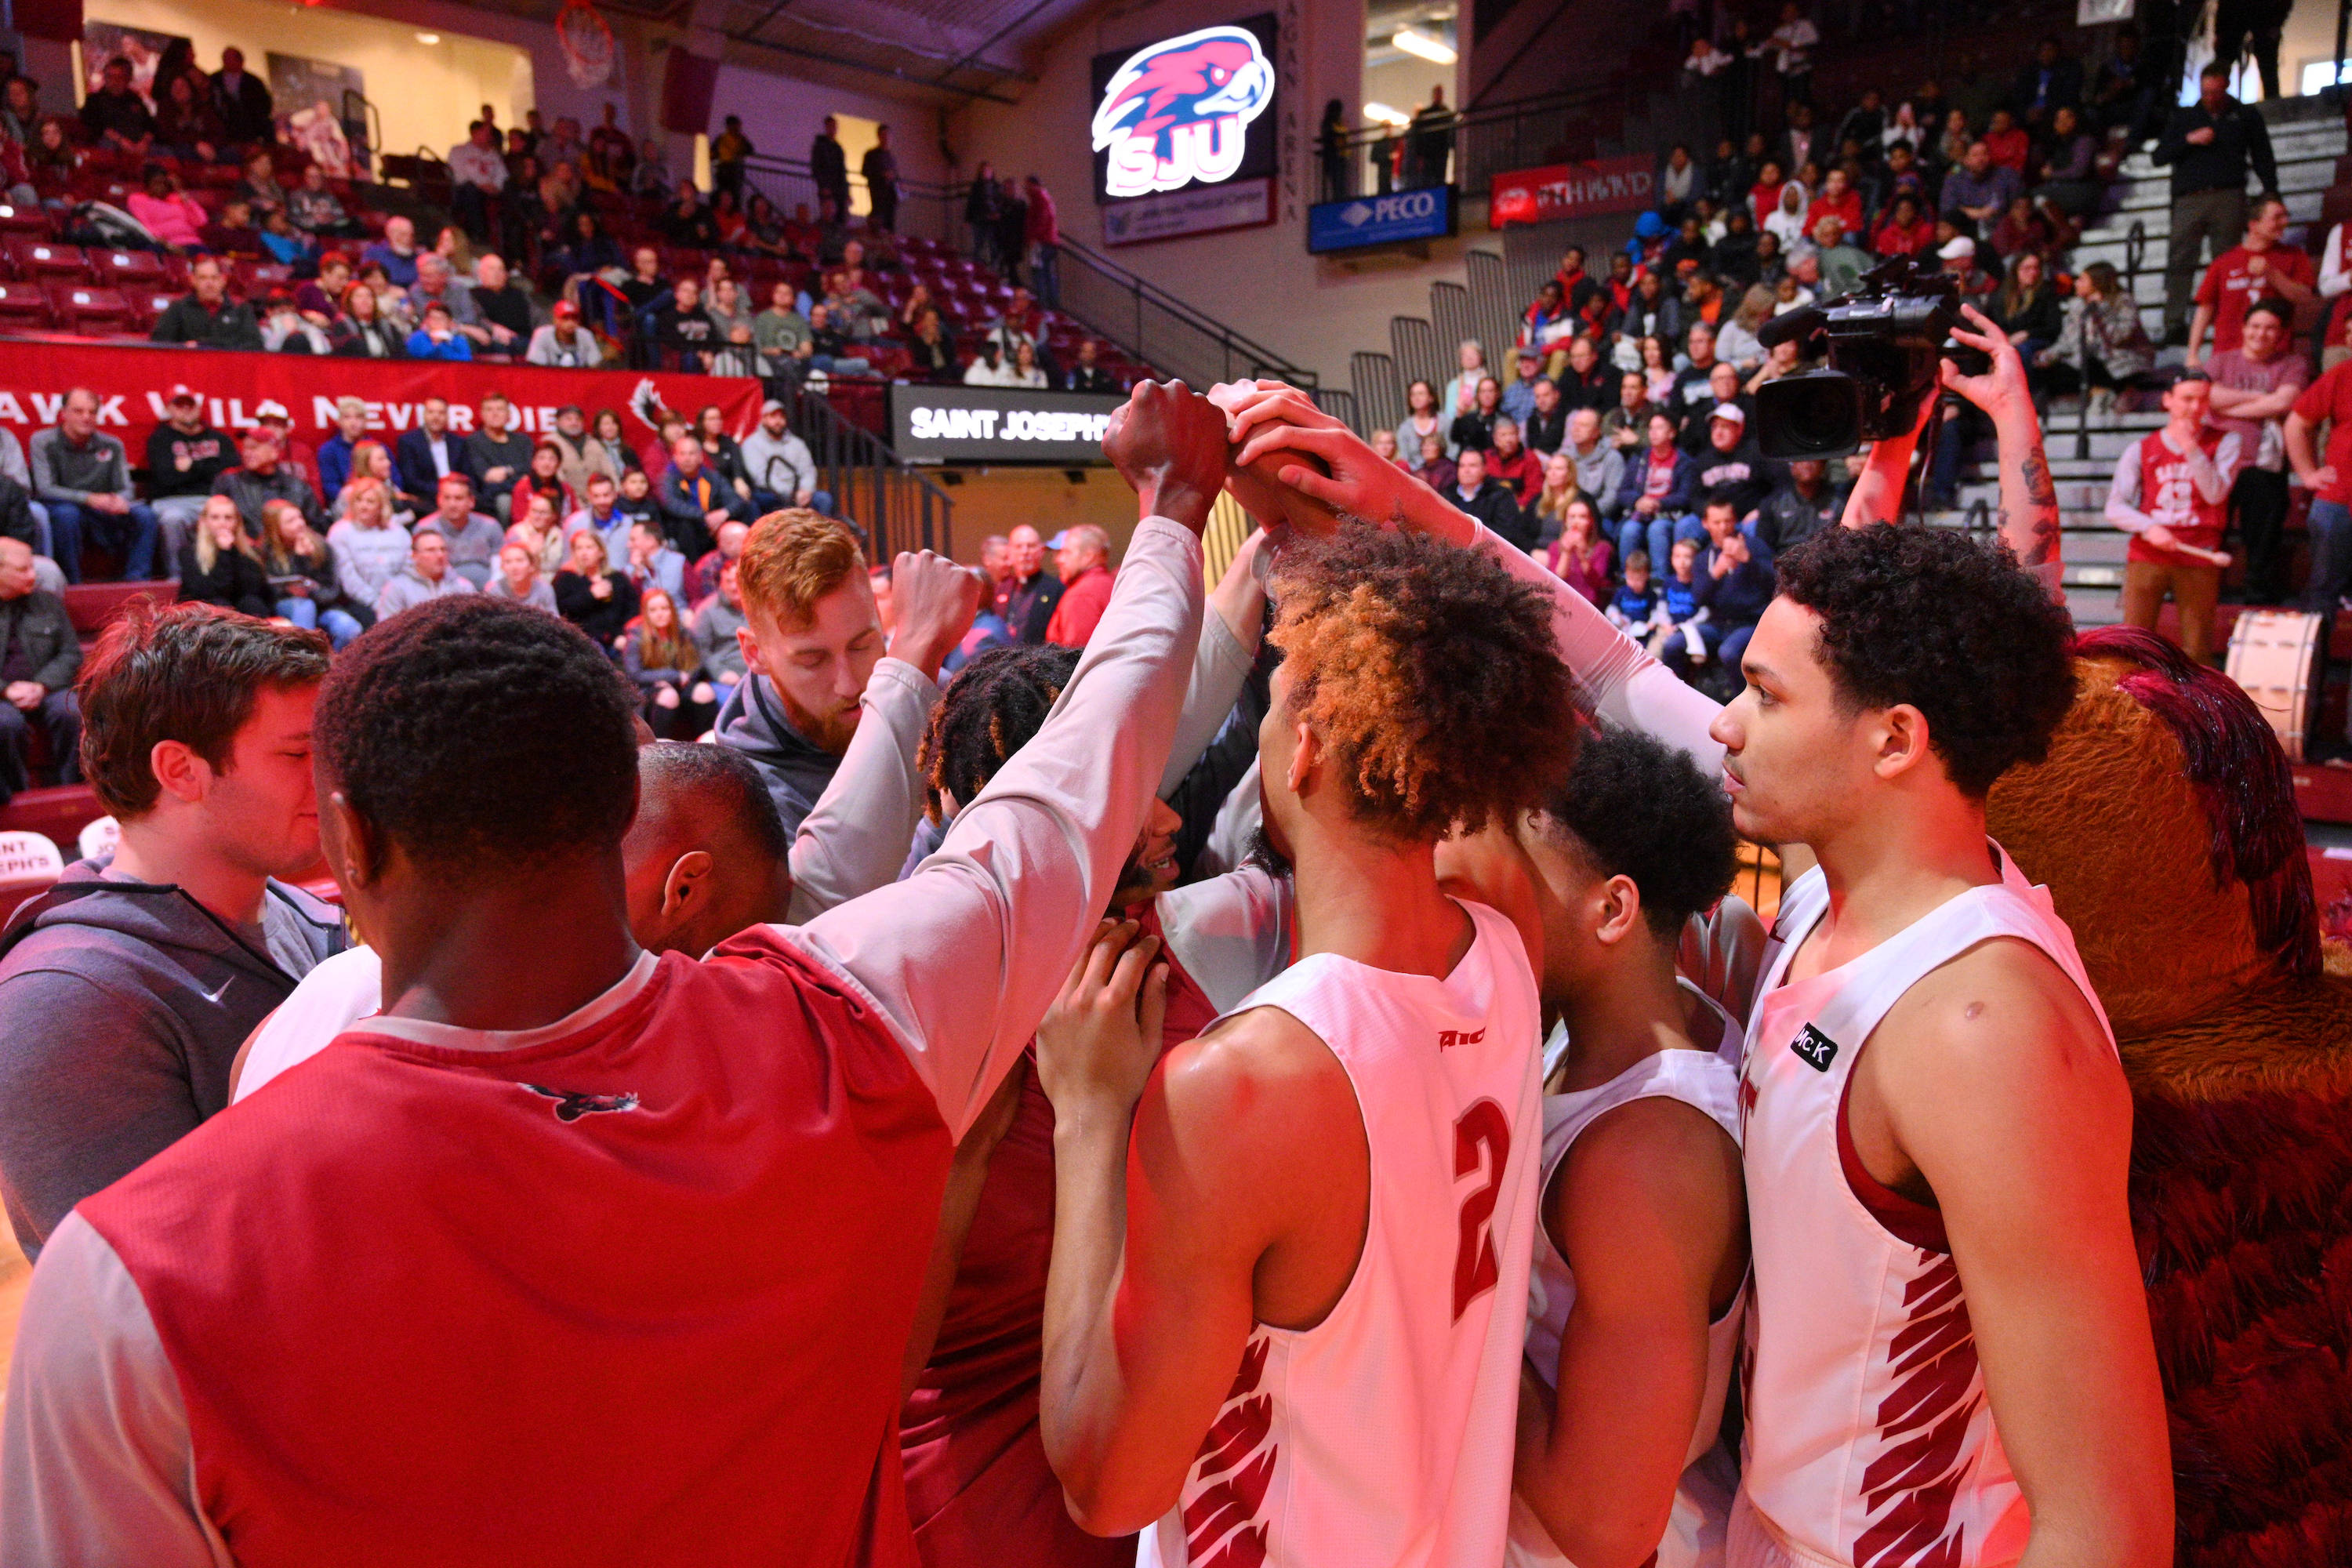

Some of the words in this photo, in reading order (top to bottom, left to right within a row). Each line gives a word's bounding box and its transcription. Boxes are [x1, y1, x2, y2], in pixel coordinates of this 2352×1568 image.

[1110, 116, 1240, 189] SJU
[1375, 192, 1434, 222] PECO
[147, 390, 295, 428] WIL
[911, 407, 999, 439] SAINT
[1795, 1028, 1831, 1064] McK
[1451, 1095, 1512, 1328] 2
